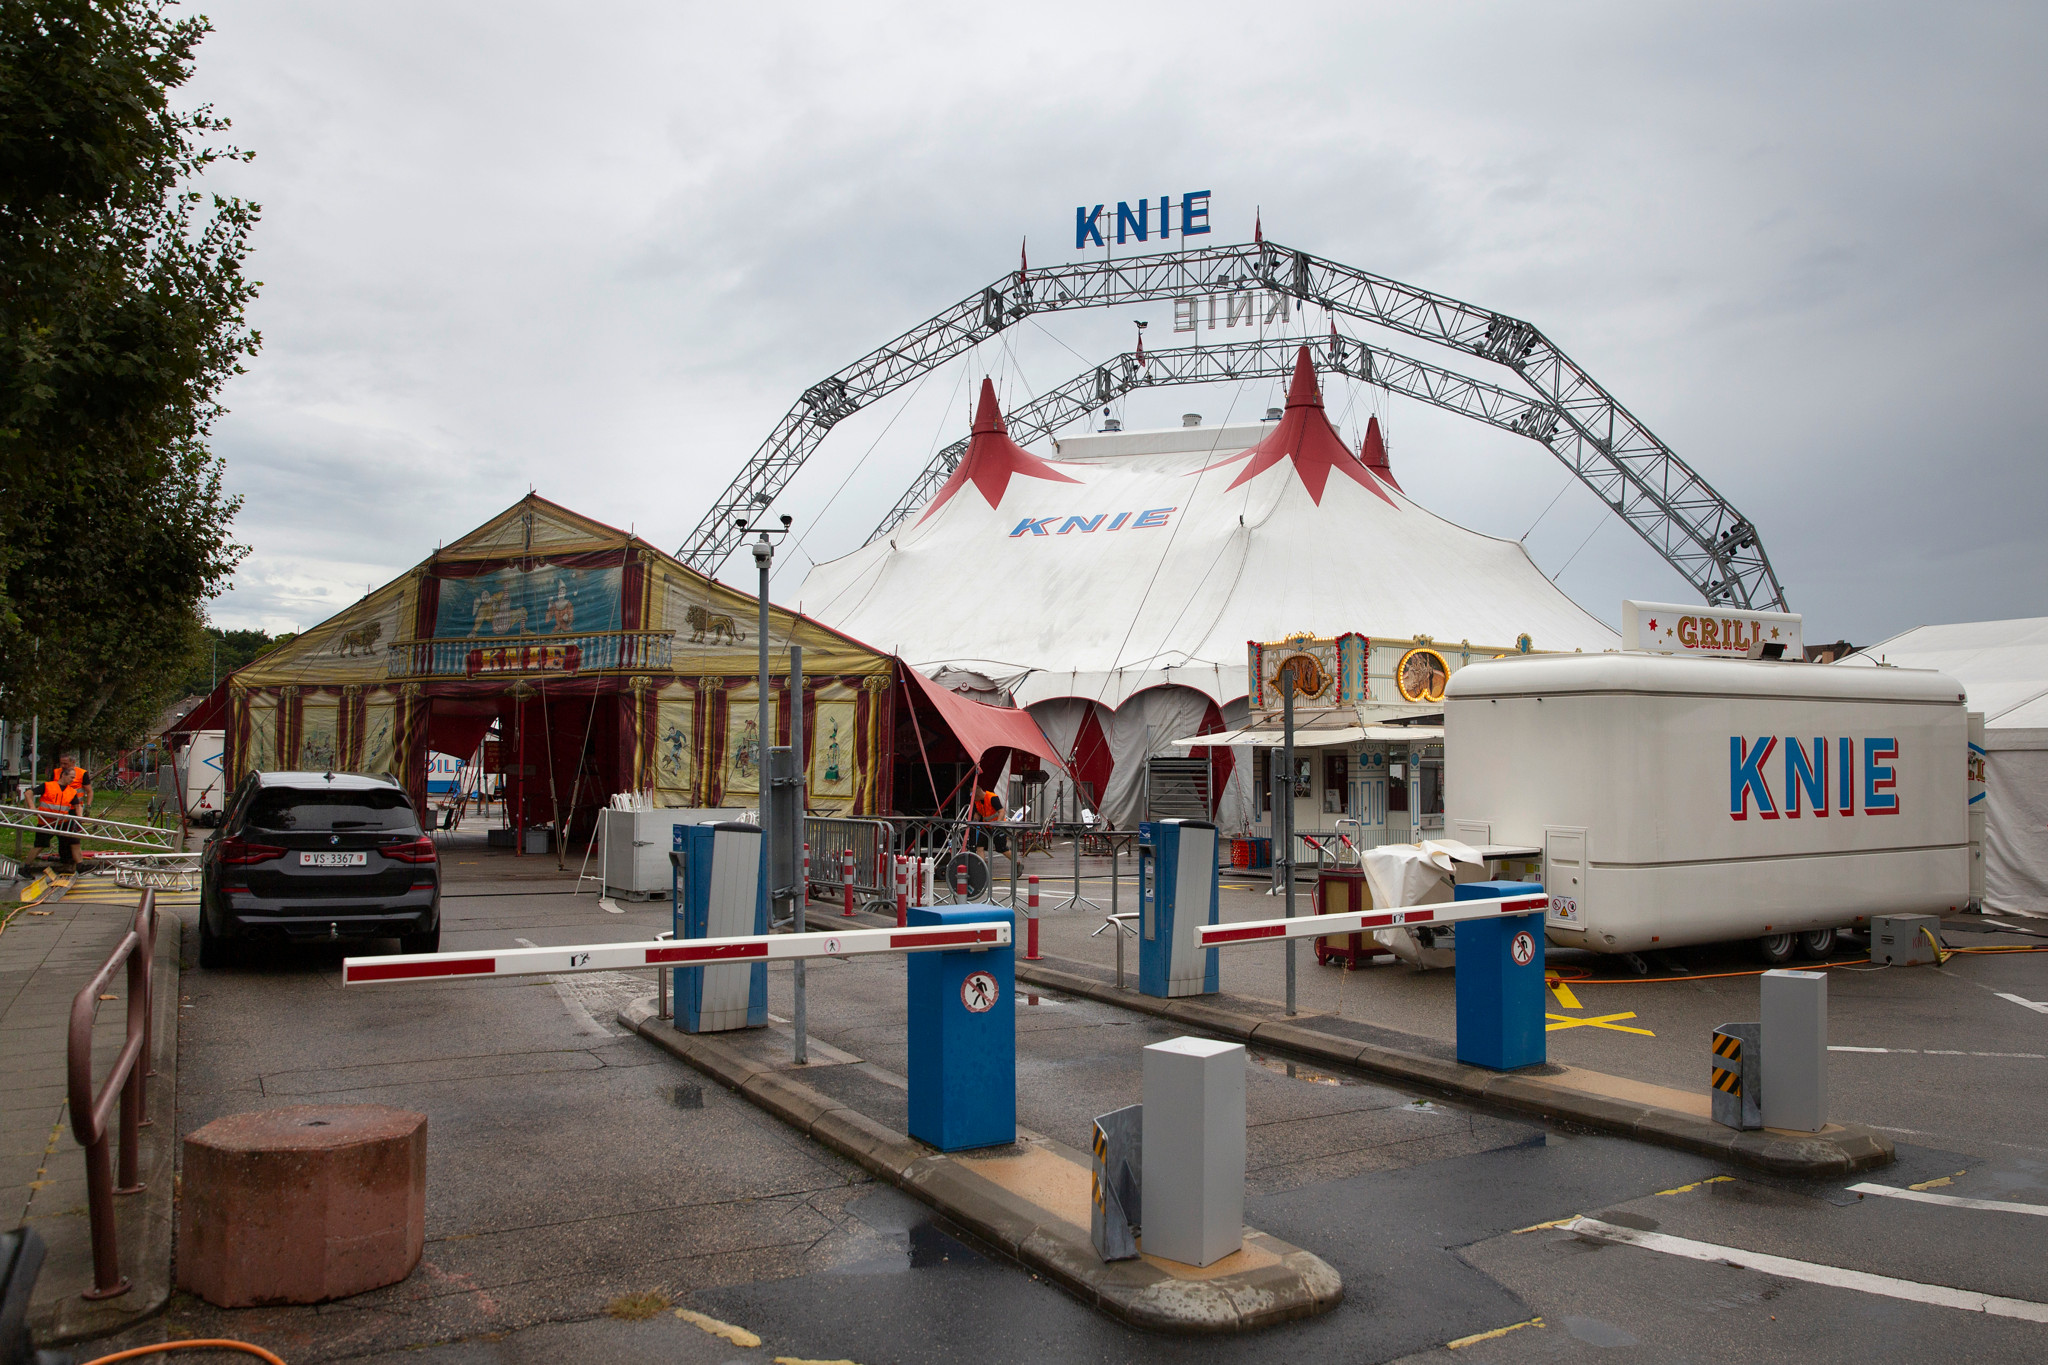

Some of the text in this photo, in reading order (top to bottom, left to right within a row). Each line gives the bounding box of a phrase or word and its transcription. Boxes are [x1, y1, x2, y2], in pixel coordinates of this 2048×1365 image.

[1076, 190, 1211, 249] KNIE
[1008, 507, 1178, 537] KNIE
[481, 647, 566, 671] KNIE
[1730, 735, 1899, 821] KNIE
